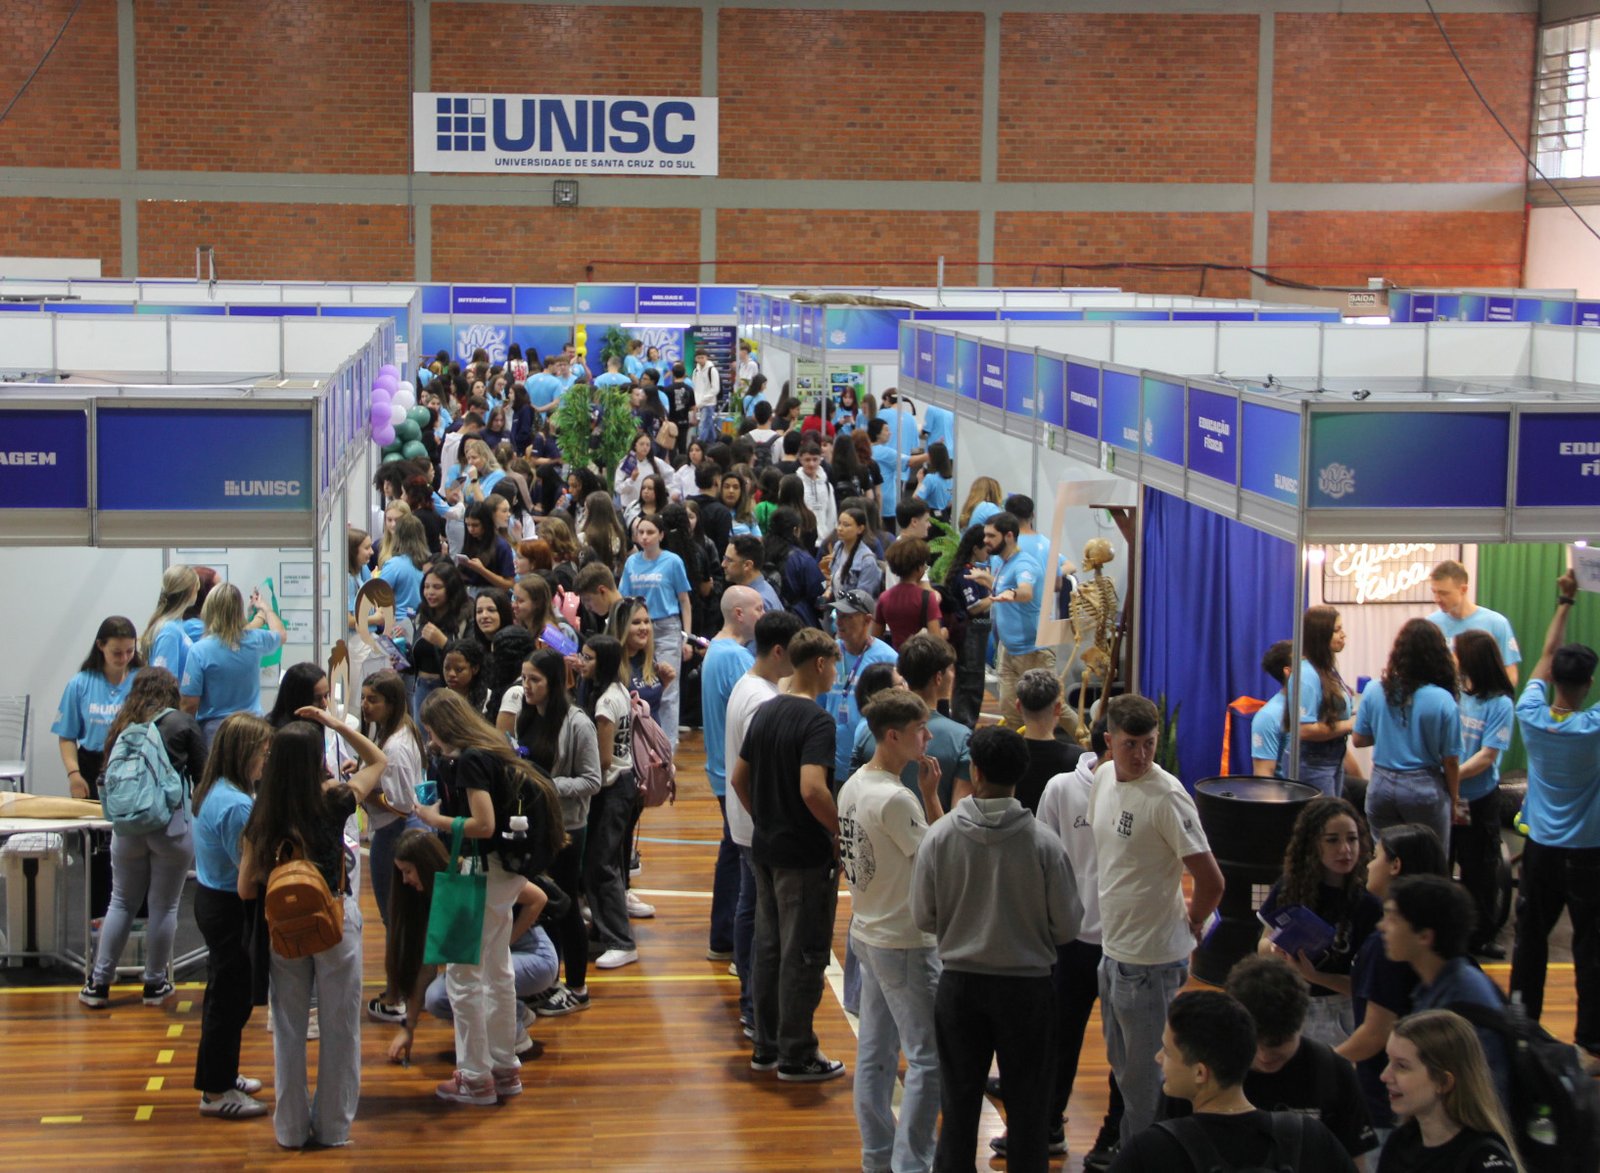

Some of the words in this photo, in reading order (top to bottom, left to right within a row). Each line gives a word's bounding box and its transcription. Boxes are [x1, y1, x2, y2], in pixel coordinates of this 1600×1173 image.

[493, 98, 696, 154] UNISC
[494, 158, 572, 167] UNIVERSIDADE
[574, 159, 588, 167] DE
[590, 159, 625, 168] SANTA
[627, 160, 655, 168] CRUZ
[659, 160, 674, 169] DO
[676, 161, 696, 169] SUL
[1199, 416, 1230, 437] EDUCAÇÃO
[1203, 434, 1224, 453] FÍSICA
[1559, 442, 1600, 455] EDU
[0, 451, 57, 465] AGEM
[241, 480, 300, 496] UNISC
